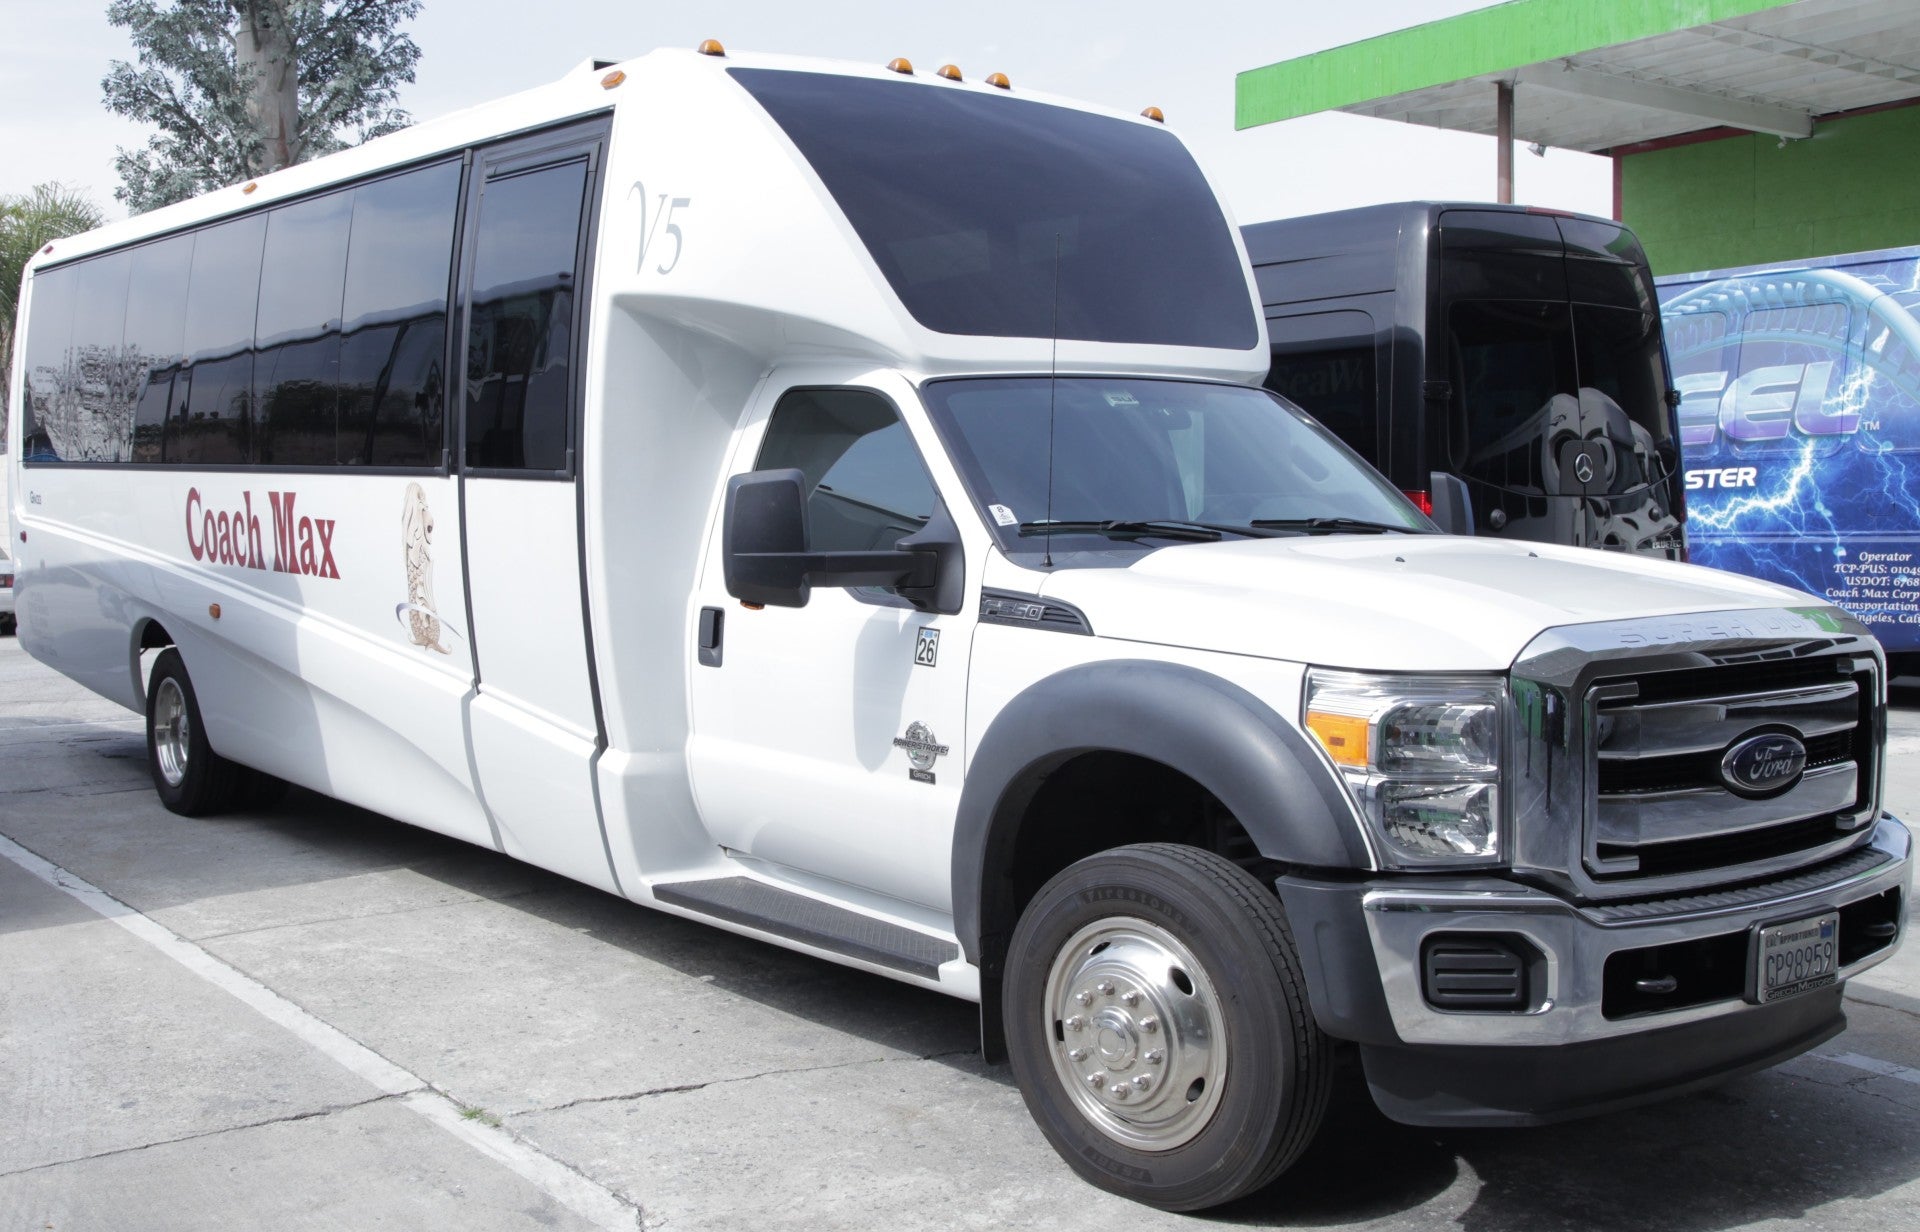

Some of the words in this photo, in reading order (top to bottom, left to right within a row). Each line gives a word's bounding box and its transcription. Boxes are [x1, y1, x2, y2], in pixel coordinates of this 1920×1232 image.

[627, 180, 691, 275] V5
[1863, 420, 1880, 431] TM
[186, 486, 267, 570] Coach
[268, 491, 341, 580] Max
[1859, 552, 1912, 564] Operator
[1833, 563, 1888, 574] TCP-PUS:
[1844, 576, 1890, 587] USDOT:
[1826, 587, 1859, 598] Coach
[1861, 588, 1889, 599] Max
[1892, 589, 1920, 602] Corp
[1833, 600, 1918, 612] Transportation
[917, 638, 935, 663] 26
[1749, 744, 1795, 780] Ford
[1766, 941, 1832, 988] CP98959
